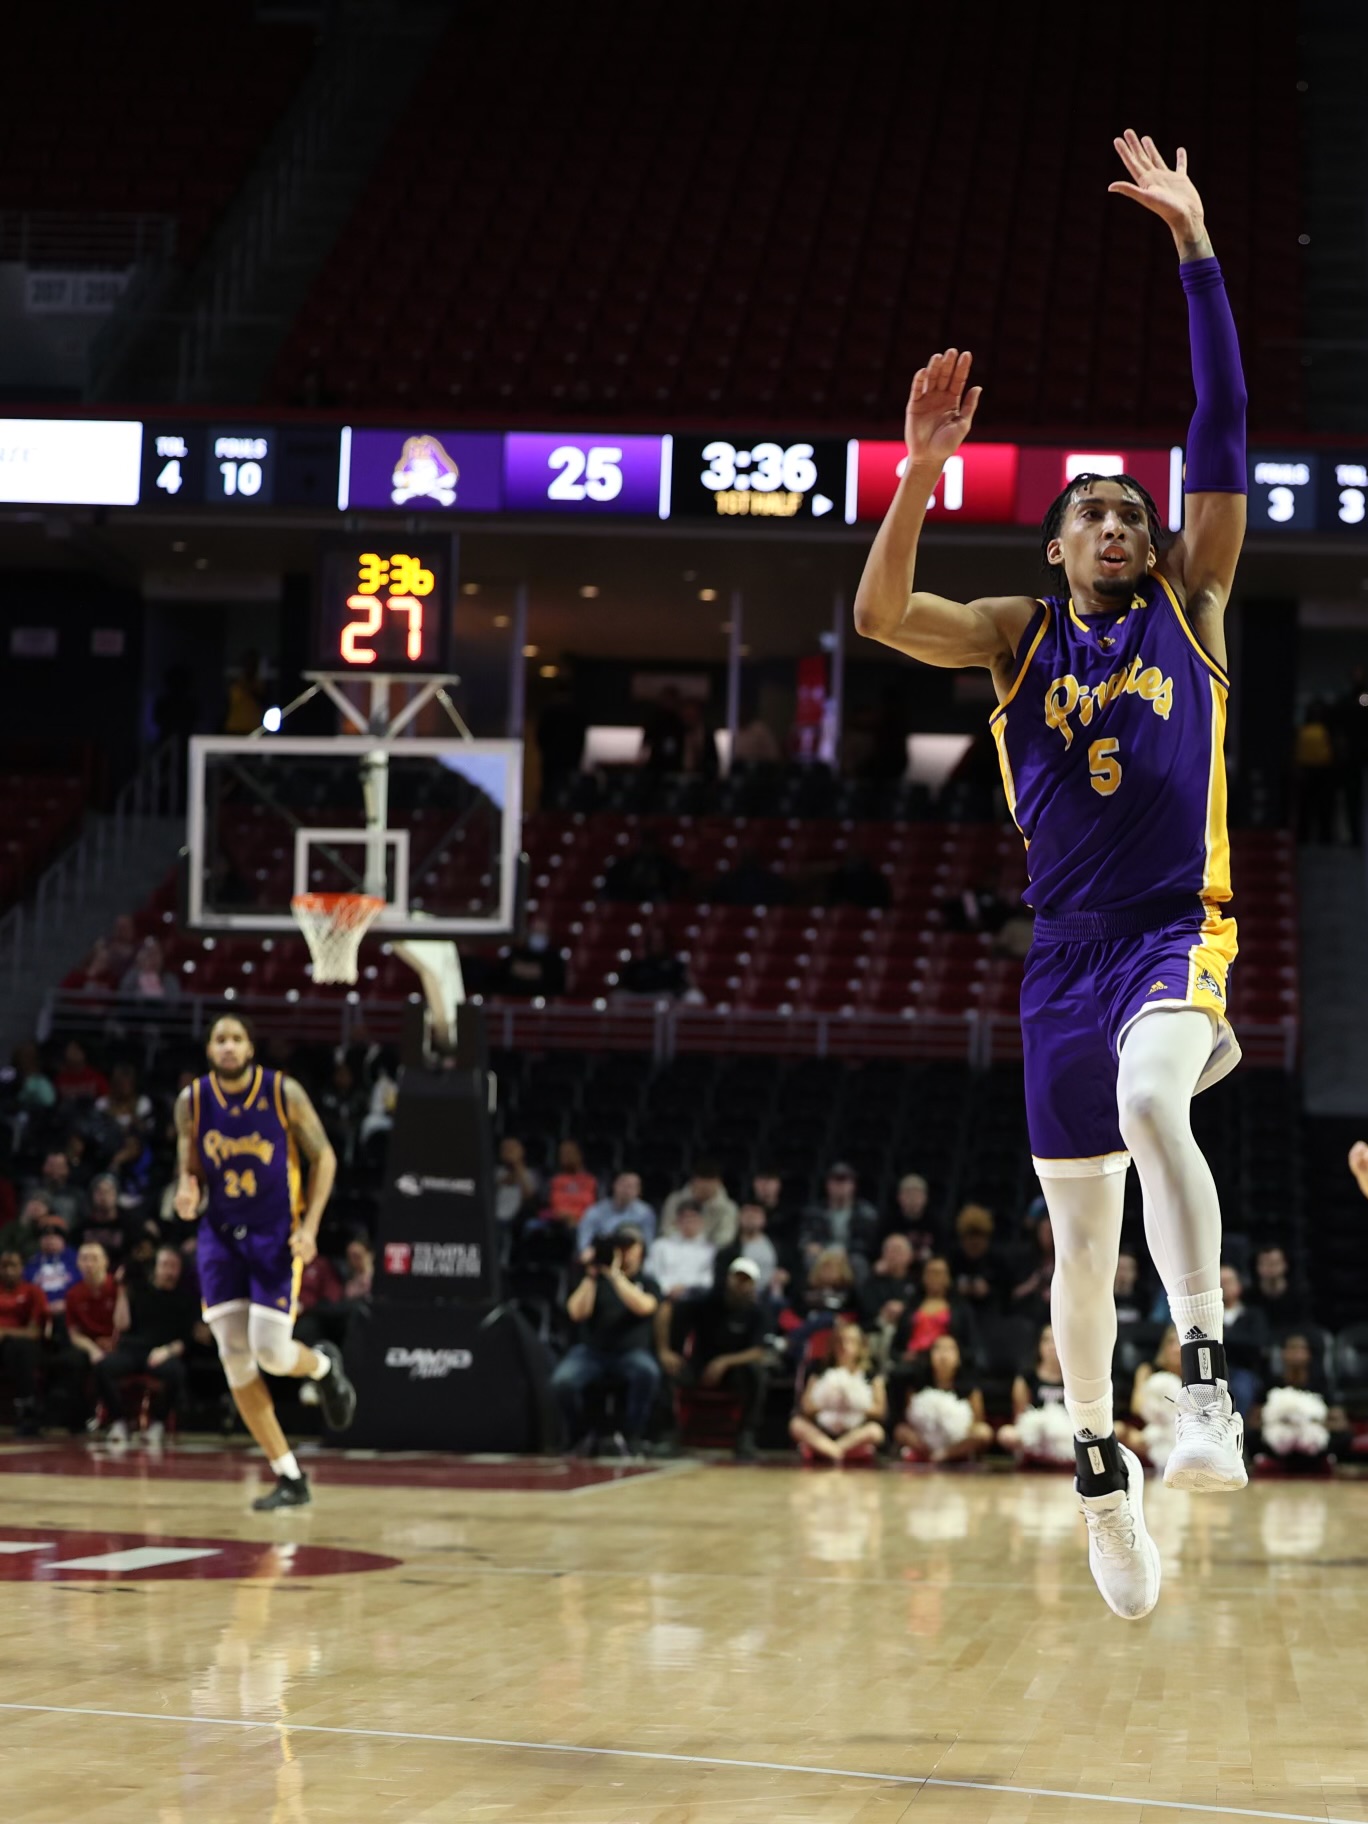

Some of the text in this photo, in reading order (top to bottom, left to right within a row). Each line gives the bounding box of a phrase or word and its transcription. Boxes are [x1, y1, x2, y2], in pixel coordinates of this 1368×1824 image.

[156, 460, 183, 494] 4
[219, 461, 262, 496] 10
[547, 446, 622, 501] 25
[700, 441, 817, 492] 3:36
[1267, 486, 1295, 522] 3
[1337, 488, 1366, 524] 3
[357, 553, 435, 596] 3:36
[340, 595, 422, 664] 27
[1045, 654, 1173, 751] Pirates
[1088, 737, 1122, 797] 5
[223, 1169, 257, 1197] 24
